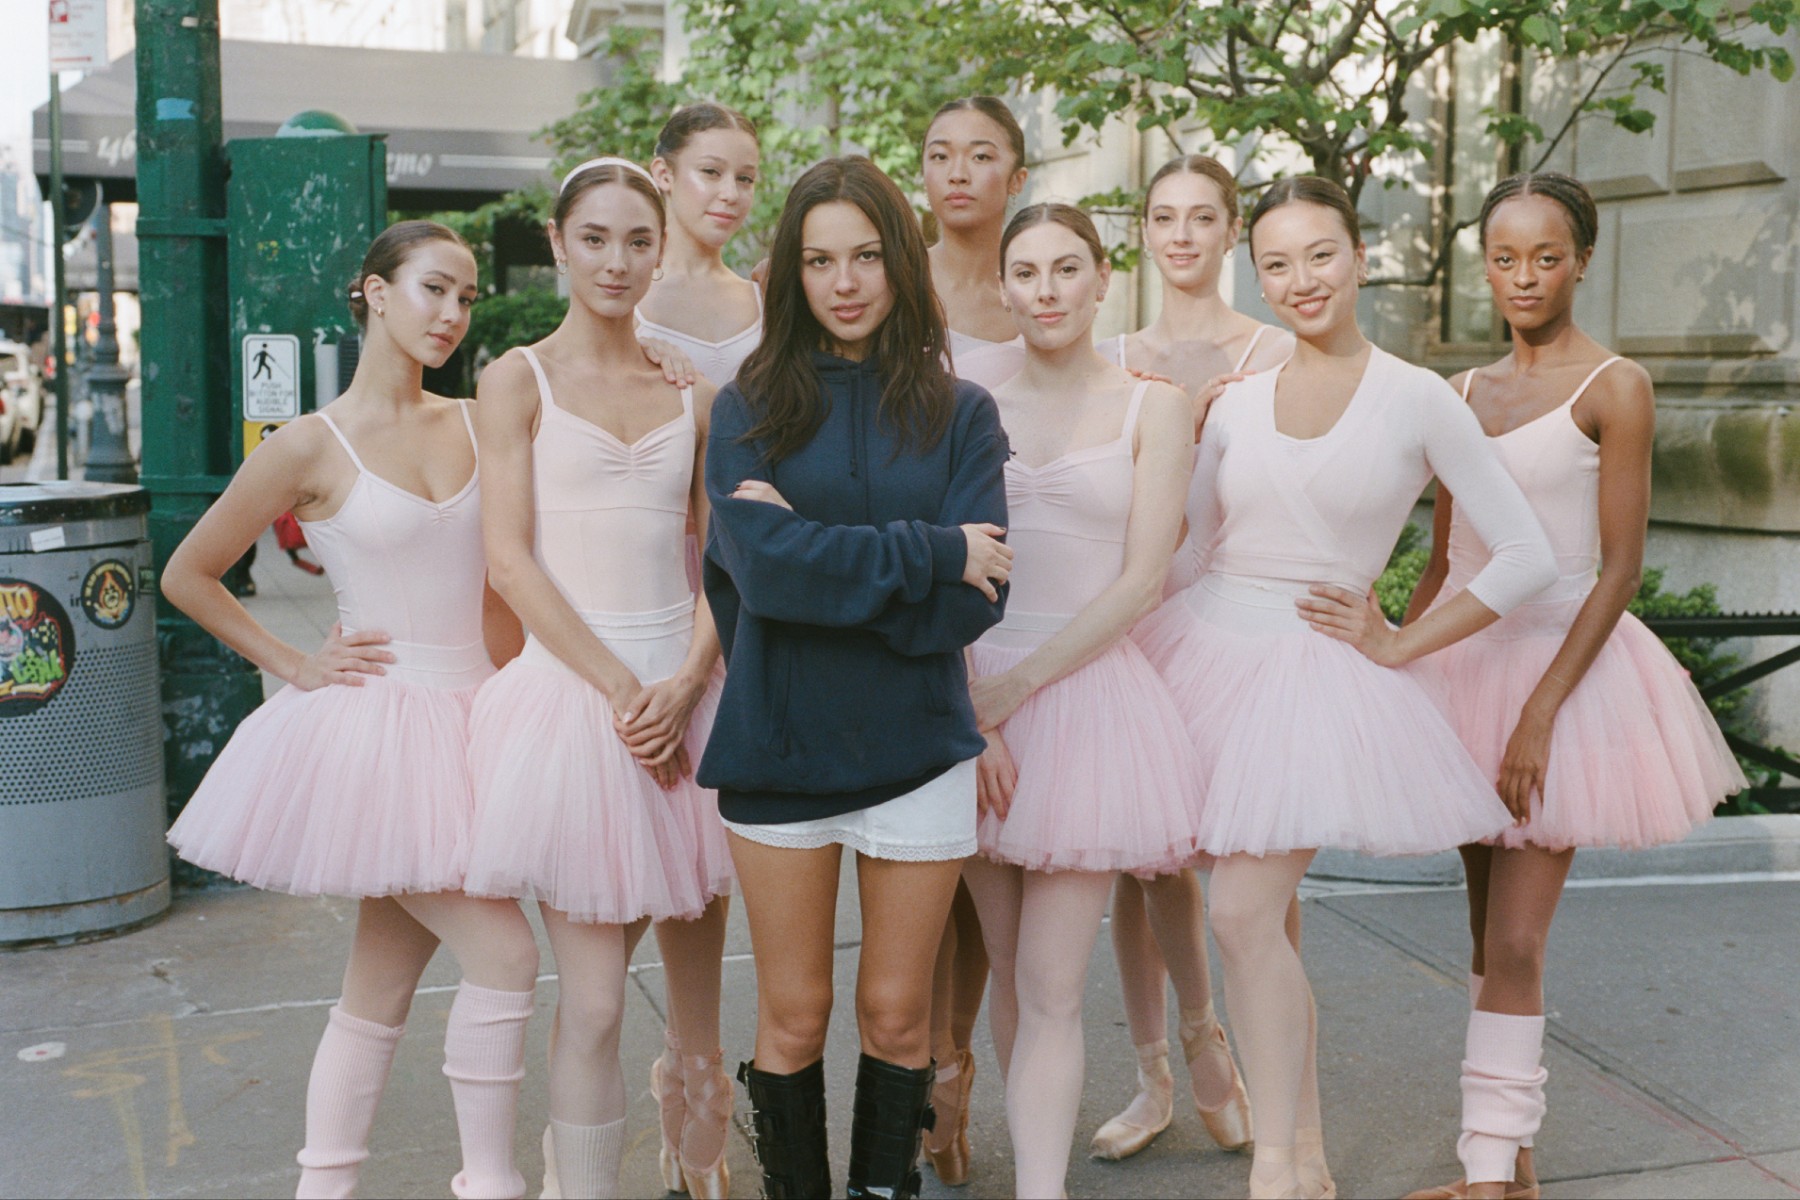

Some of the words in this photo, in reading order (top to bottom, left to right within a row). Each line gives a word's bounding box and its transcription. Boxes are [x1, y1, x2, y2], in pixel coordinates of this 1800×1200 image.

[261, 381, 282, 389] PUSH
[248, 389, 277, 397] BUTTON
[279, 389, 293, 397] FOR
[256, 397, 288, 405] AUDIBLE
[258, 405, 285, 413] SIGNAL
